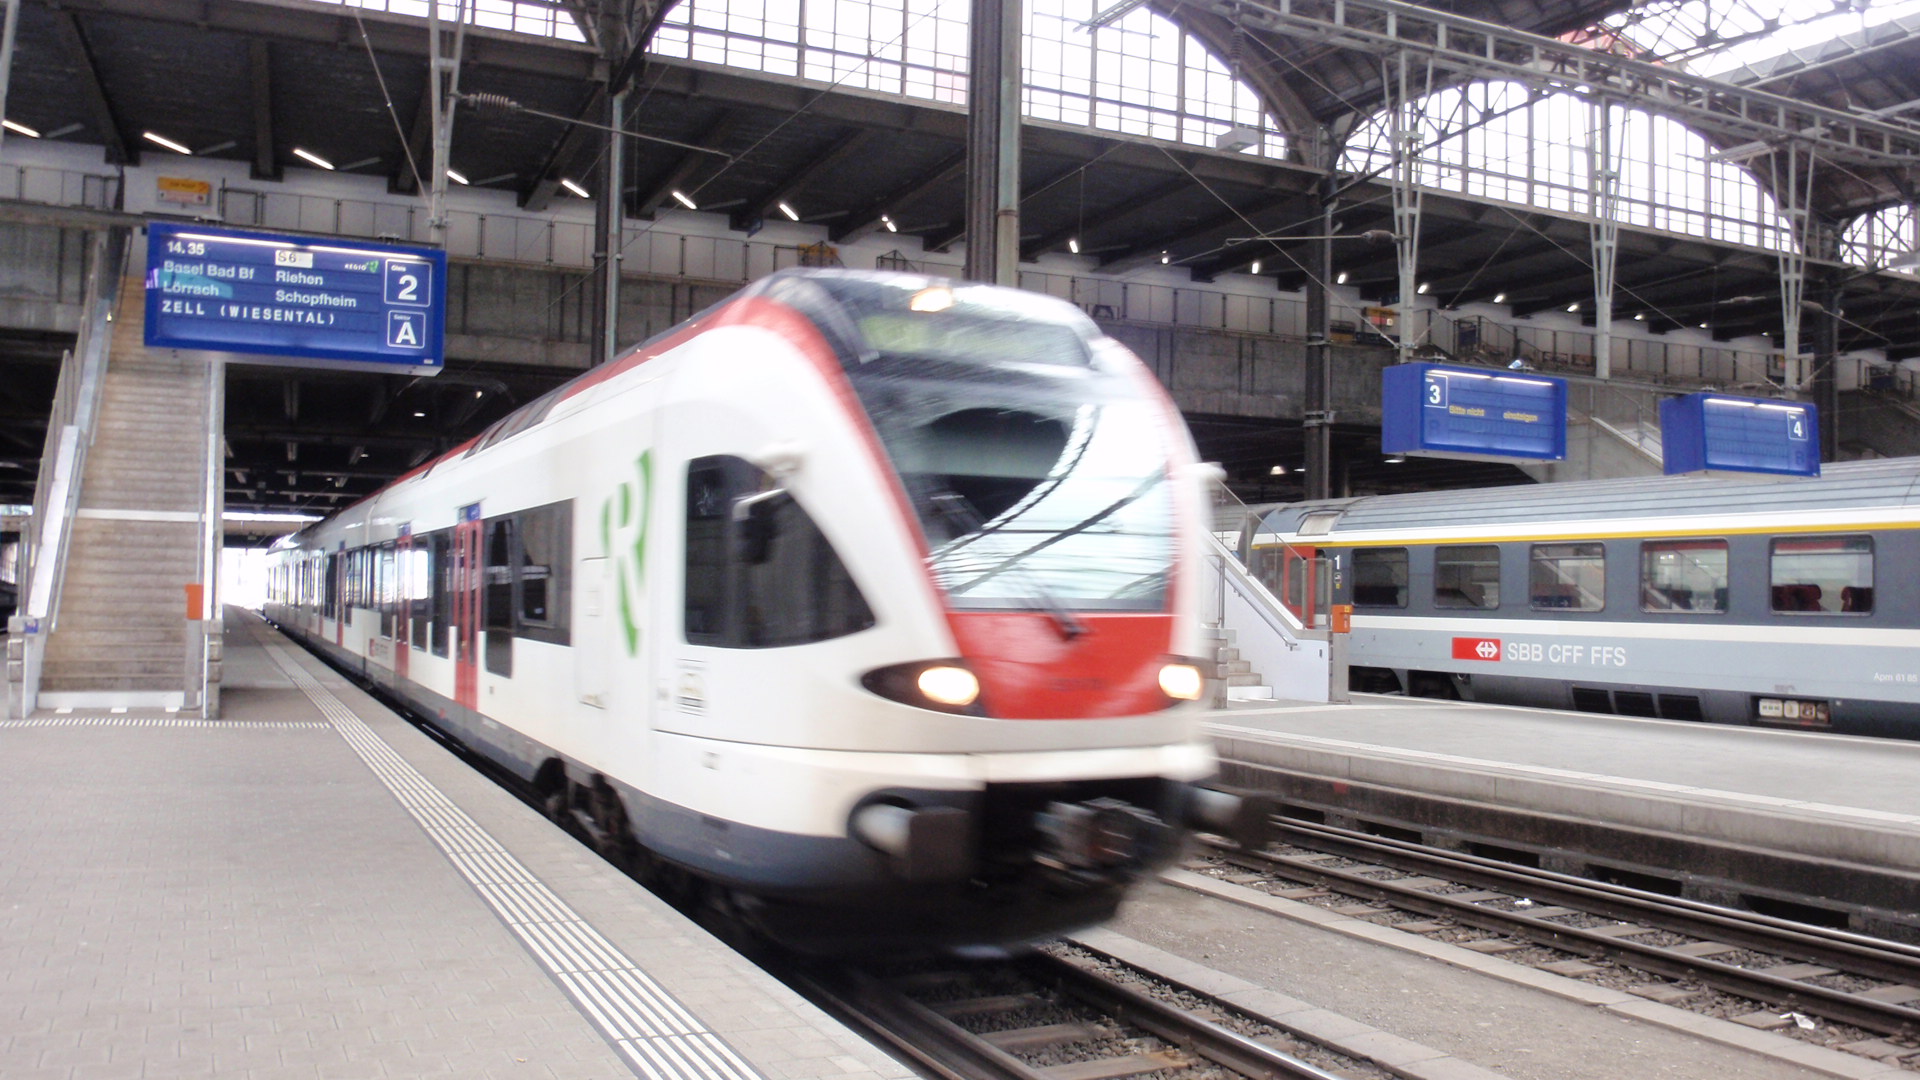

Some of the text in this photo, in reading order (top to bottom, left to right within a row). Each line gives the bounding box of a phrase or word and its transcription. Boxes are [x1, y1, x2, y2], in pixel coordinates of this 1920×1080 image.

[167, 241, 205, 255] 14.35
[163, 260, 255, 279] Basel Bad Bf
[276, 270, 324, 285] Riehen
[163, 281, 220, 296] Lörrach
[397, 274, 418, 301] 2
[275, 289, 357, 308] Schopfheim
[162, 300, 334, 325] ZELL (WIESENTAL)
[395, 321, 417, 344] A
[1429, 384, 1441, 404] 3
[1793, 421, 1802, 437] 4
[1334, 554, 1341, 570] 1
[1507, 642, 1627, 667] SBB CFF FFS
